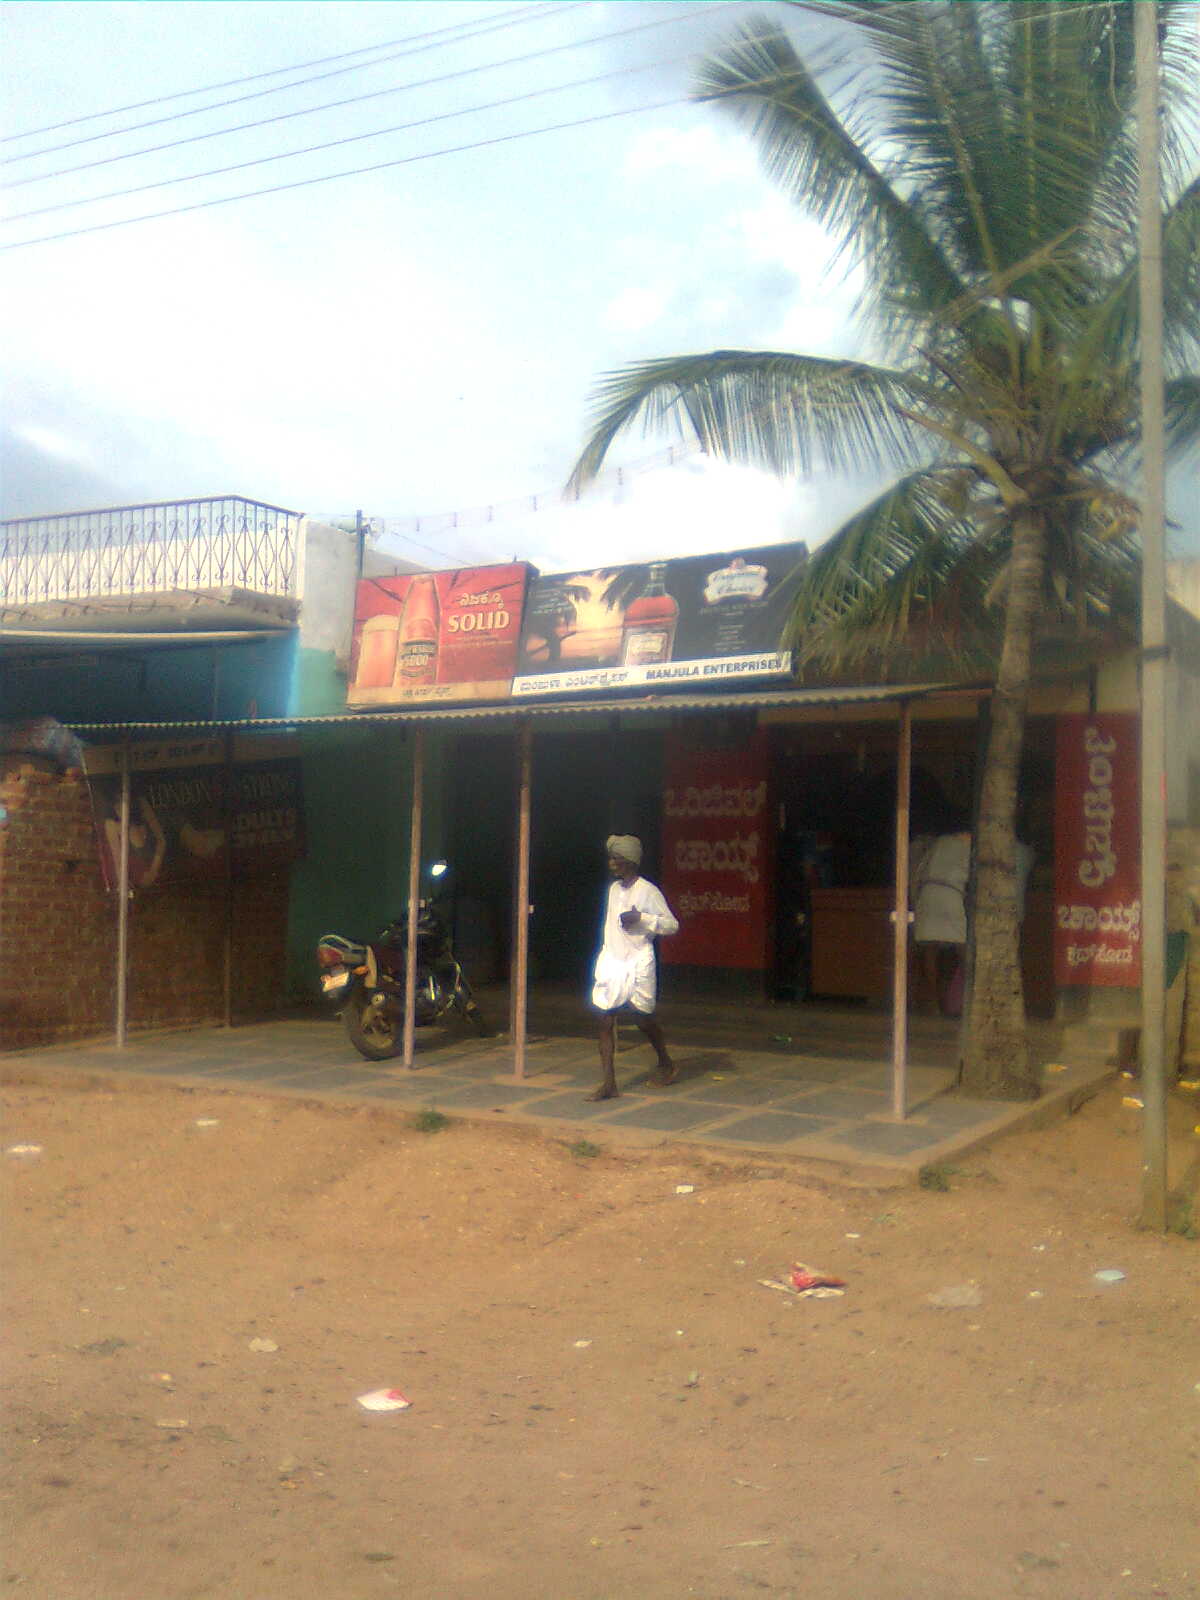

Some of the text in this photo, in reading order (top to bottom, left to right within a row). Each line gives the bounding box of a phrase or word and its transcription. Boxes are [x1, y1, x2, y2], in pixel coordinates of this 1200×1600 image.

[448, 611, 510, 632] SOLID
[646, 657, 782, 680] MANJULA ENTERPRISES
